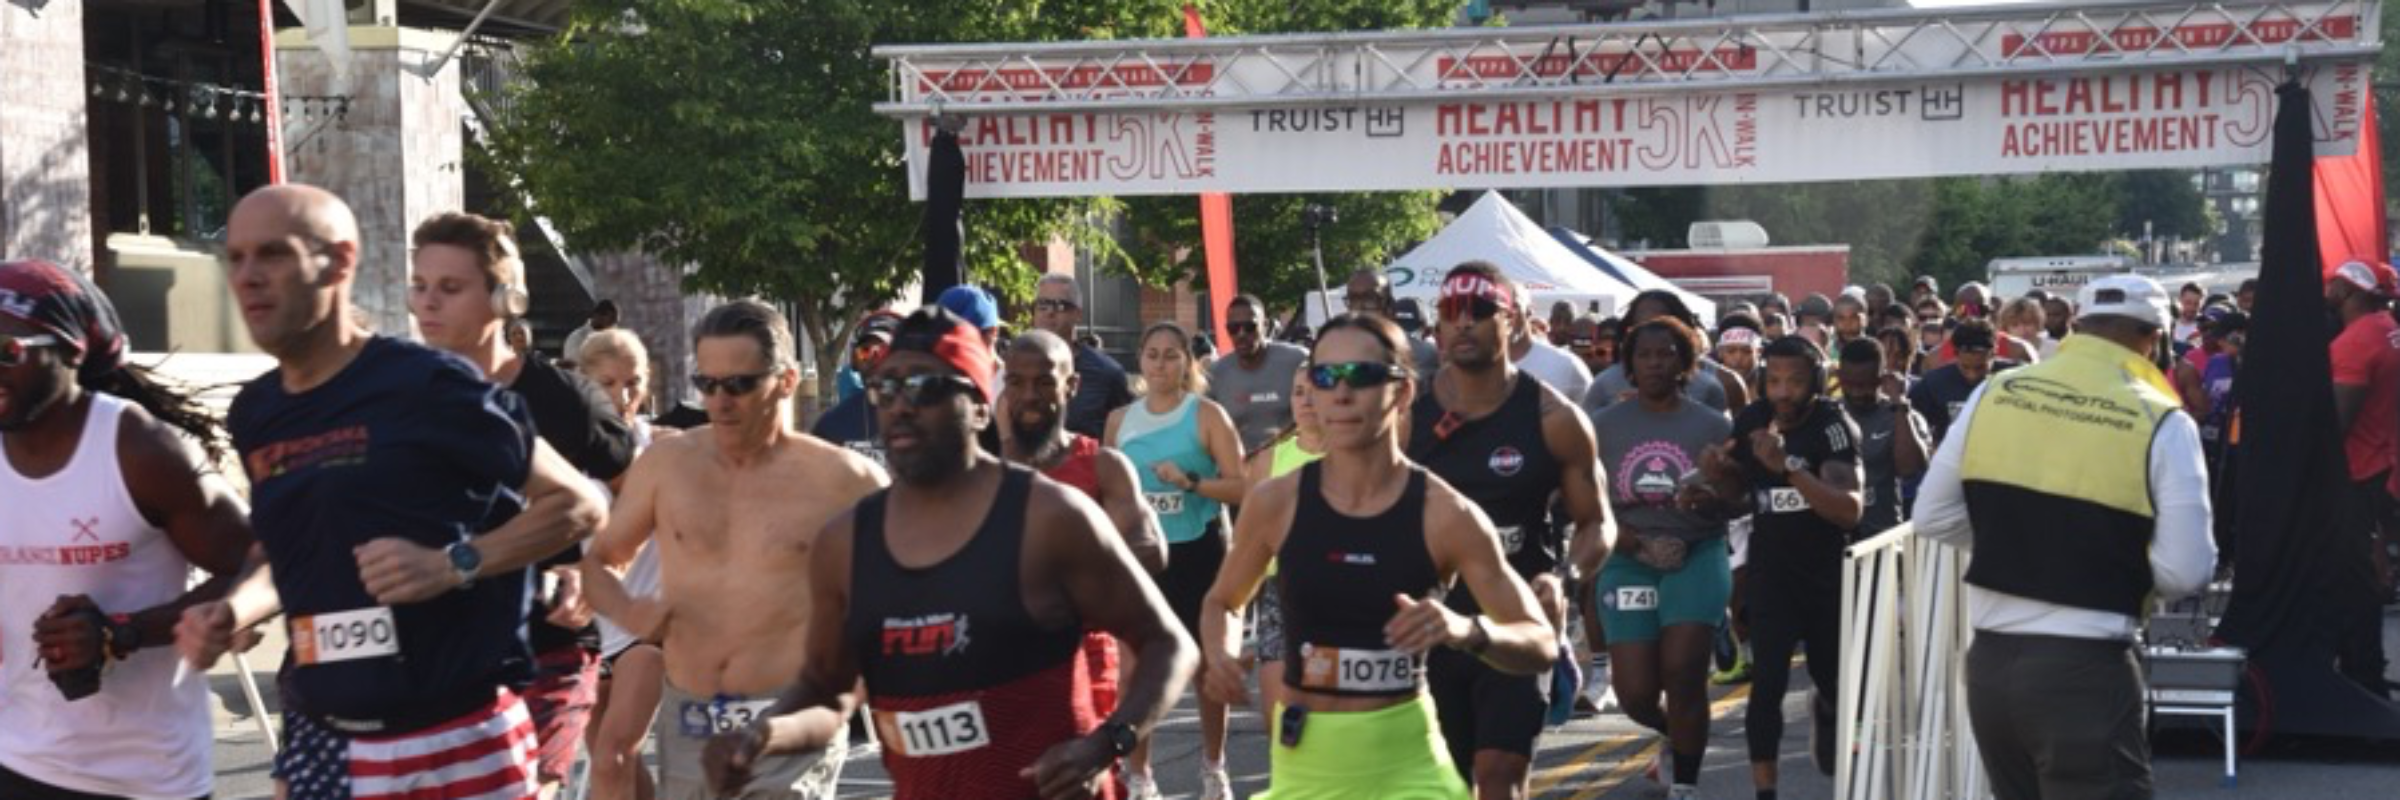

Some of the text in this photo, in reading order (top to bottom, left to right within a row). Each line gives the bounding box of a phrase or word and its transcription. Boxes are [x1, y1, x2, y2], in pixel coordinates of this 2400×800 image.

[1249, 106, 1358, 132] TRUIST
[1793, 90, 1912, 118] TRUIST
[922, 100, 1097, 148] ALTHY
[1107, 100, 1194, 180] 5K
[1637, 93, 1732, 171] 5K
[2001, 114, 2219, 157] ACHIEVEMENT
[963, 150, 1104, 184] HIEVEMENT
[1437, 138, 1634, 175] ACHIEVEMENT
[2040, 403, 2134, 432] PHOTOGRAPHER
[1773, 491, 1803, 509] 66
[60, 541, 130, 566] NUPES
[1621, 590, 1656, 606] 741
[319, 617, 391, 650] 1090
[1341, 655, 1410, 682] 1078
[903, 711, 979, 750] 1113
